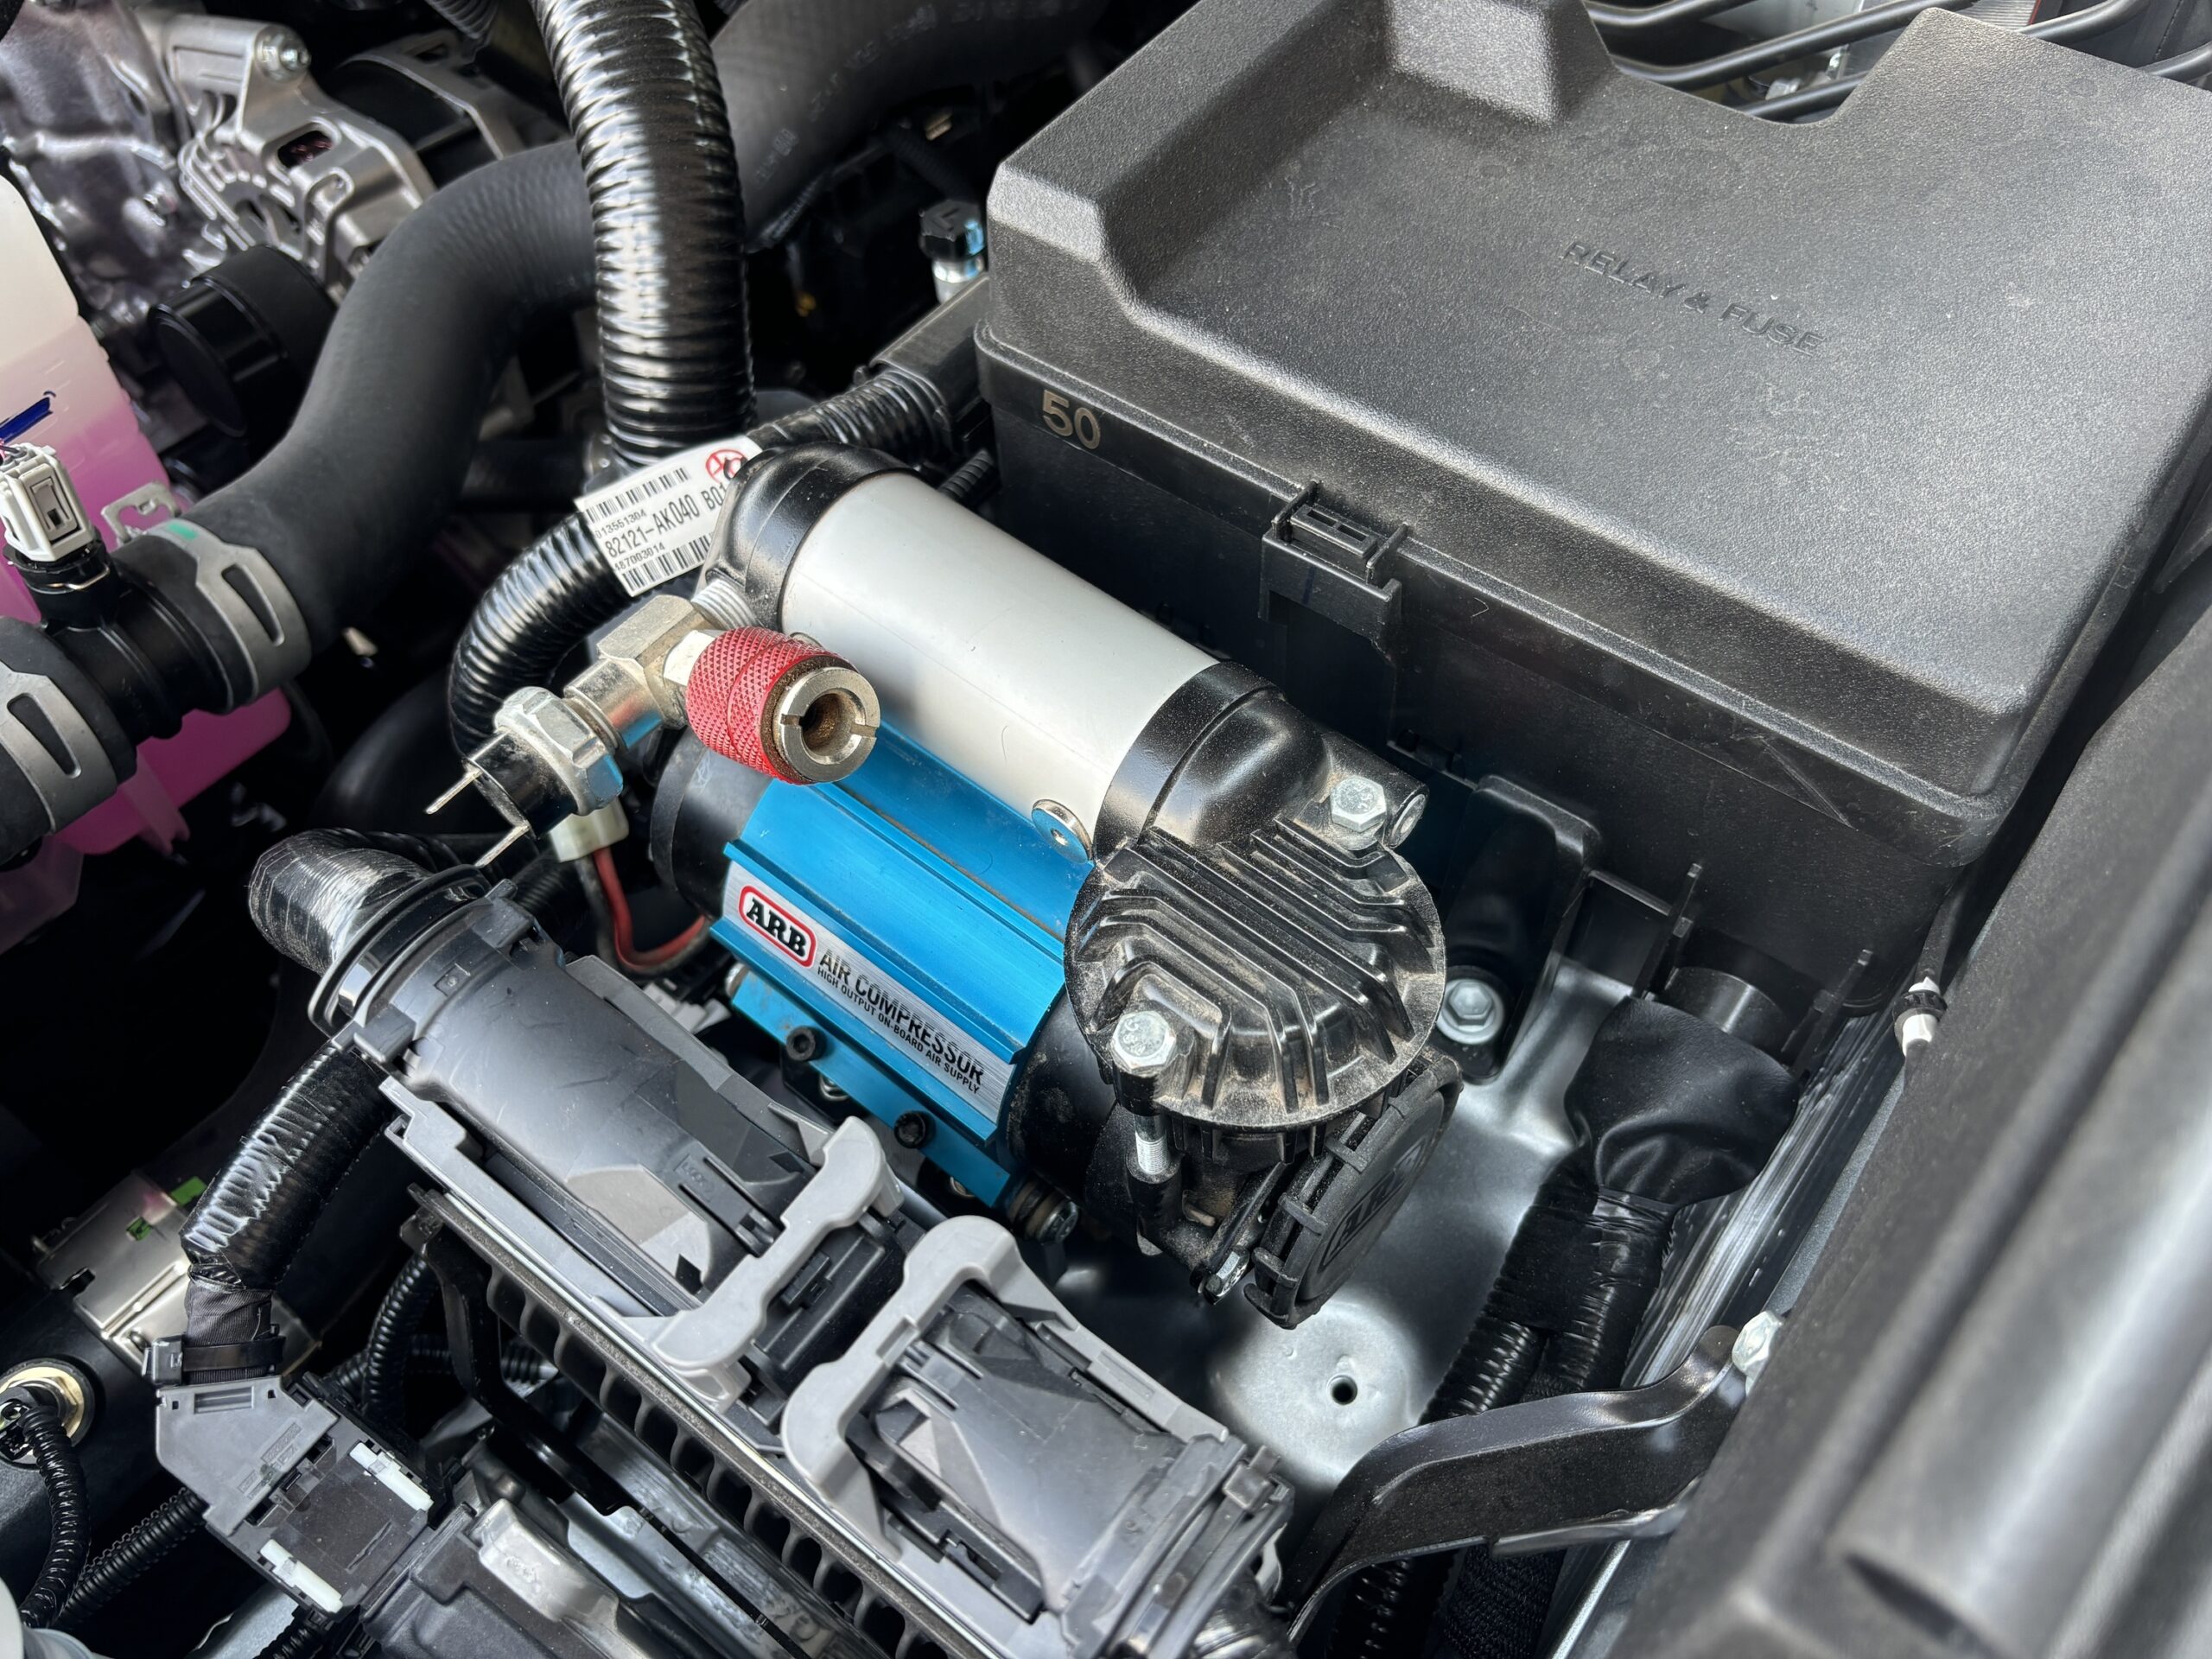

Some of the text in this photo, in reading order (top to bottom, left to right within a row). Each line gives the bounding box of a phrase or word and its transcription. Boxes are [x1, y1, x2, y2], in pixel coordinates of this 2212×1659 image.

[1558, 239, 1827, 358] RELAY & FUSE
[1042, 389, 1101, 450] 50
[605, 493, 700, 558] 82121-AK040
[746, 897, 807, 958] ARB
[817, 967, 980, 1095] HIGH OUTPUT ON-BOARD AIR SUPPLY
[818, 948, 985, 1085] AIR COMPRESSOR
